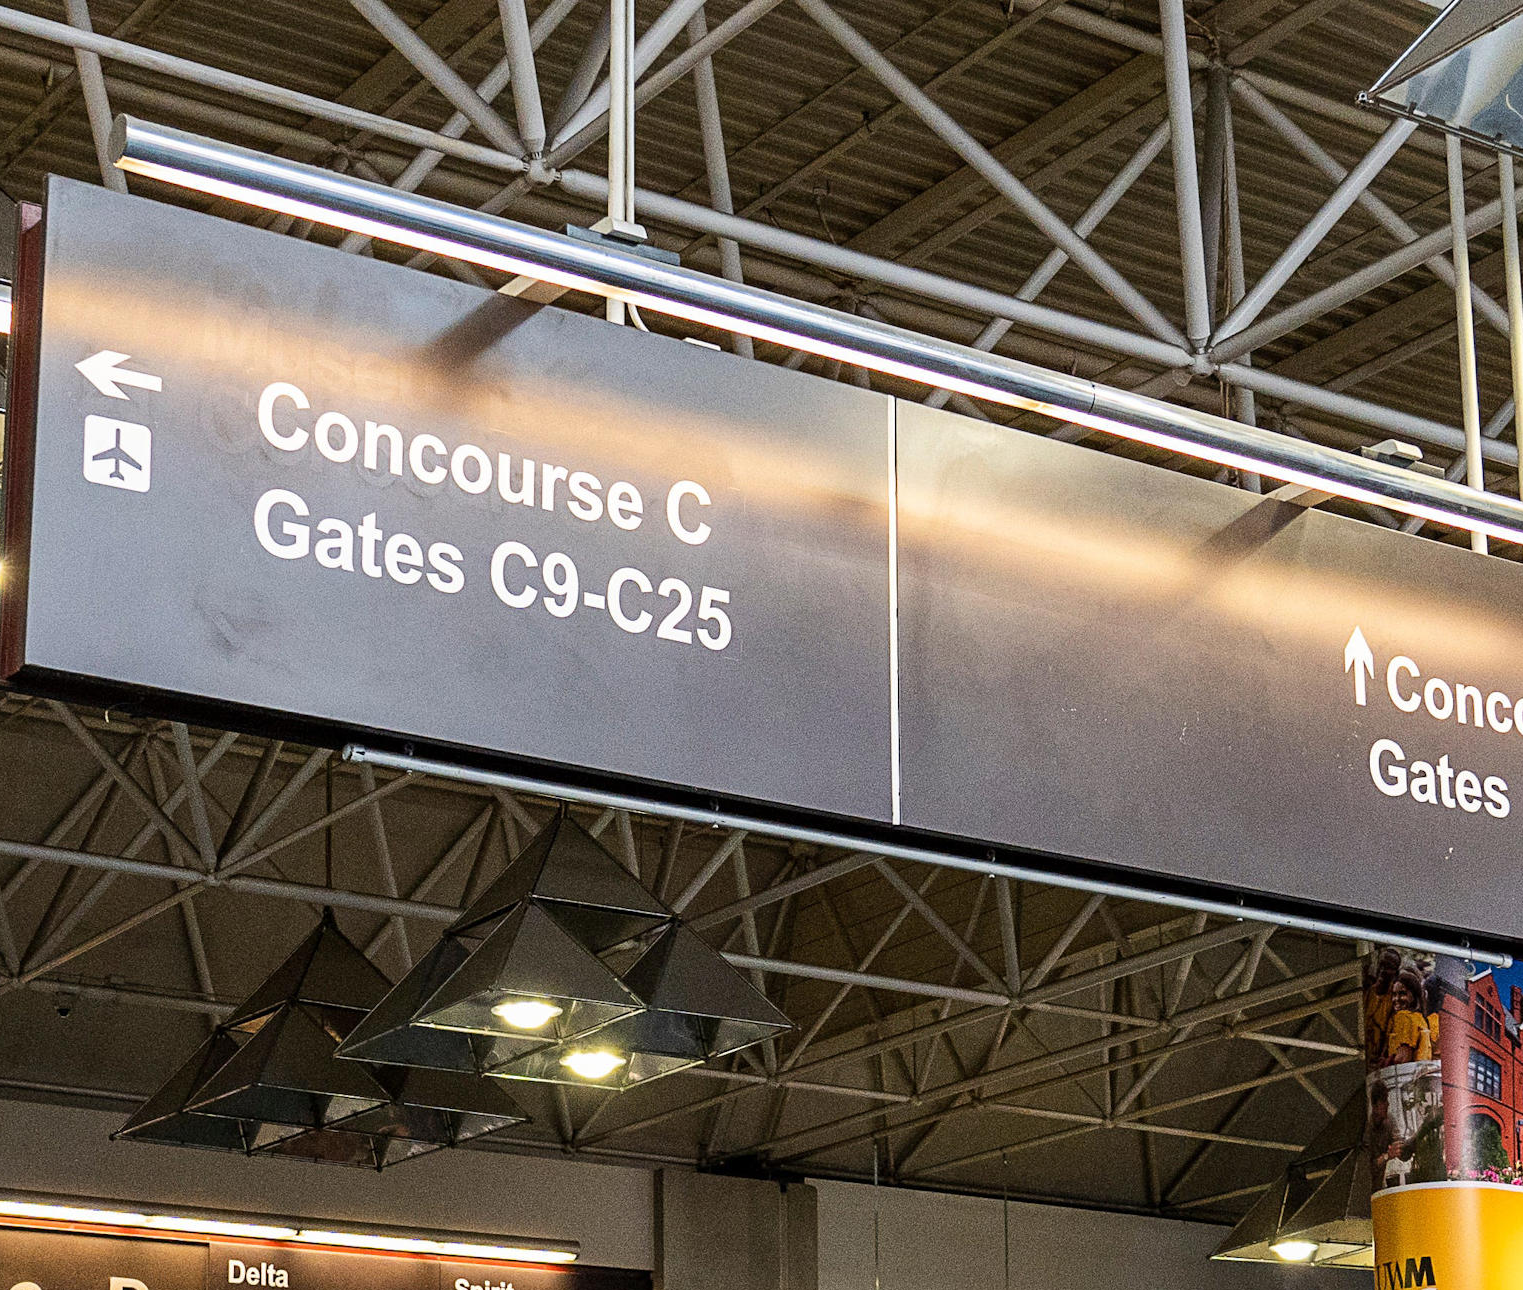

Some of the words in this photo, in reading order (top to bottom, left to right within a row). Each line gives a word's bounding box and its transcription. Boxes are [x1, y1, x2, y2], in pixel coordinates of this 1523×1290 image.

[257, 379, 644, 531] Concourse
[665, 478, 713, 546] C
[253, 488, 466, 594] Gates
[490, 540, 733, 651] C9-C25
[1369, 738, 1511, 818] Gates
[226, 1258, 290, 1289] Delta
